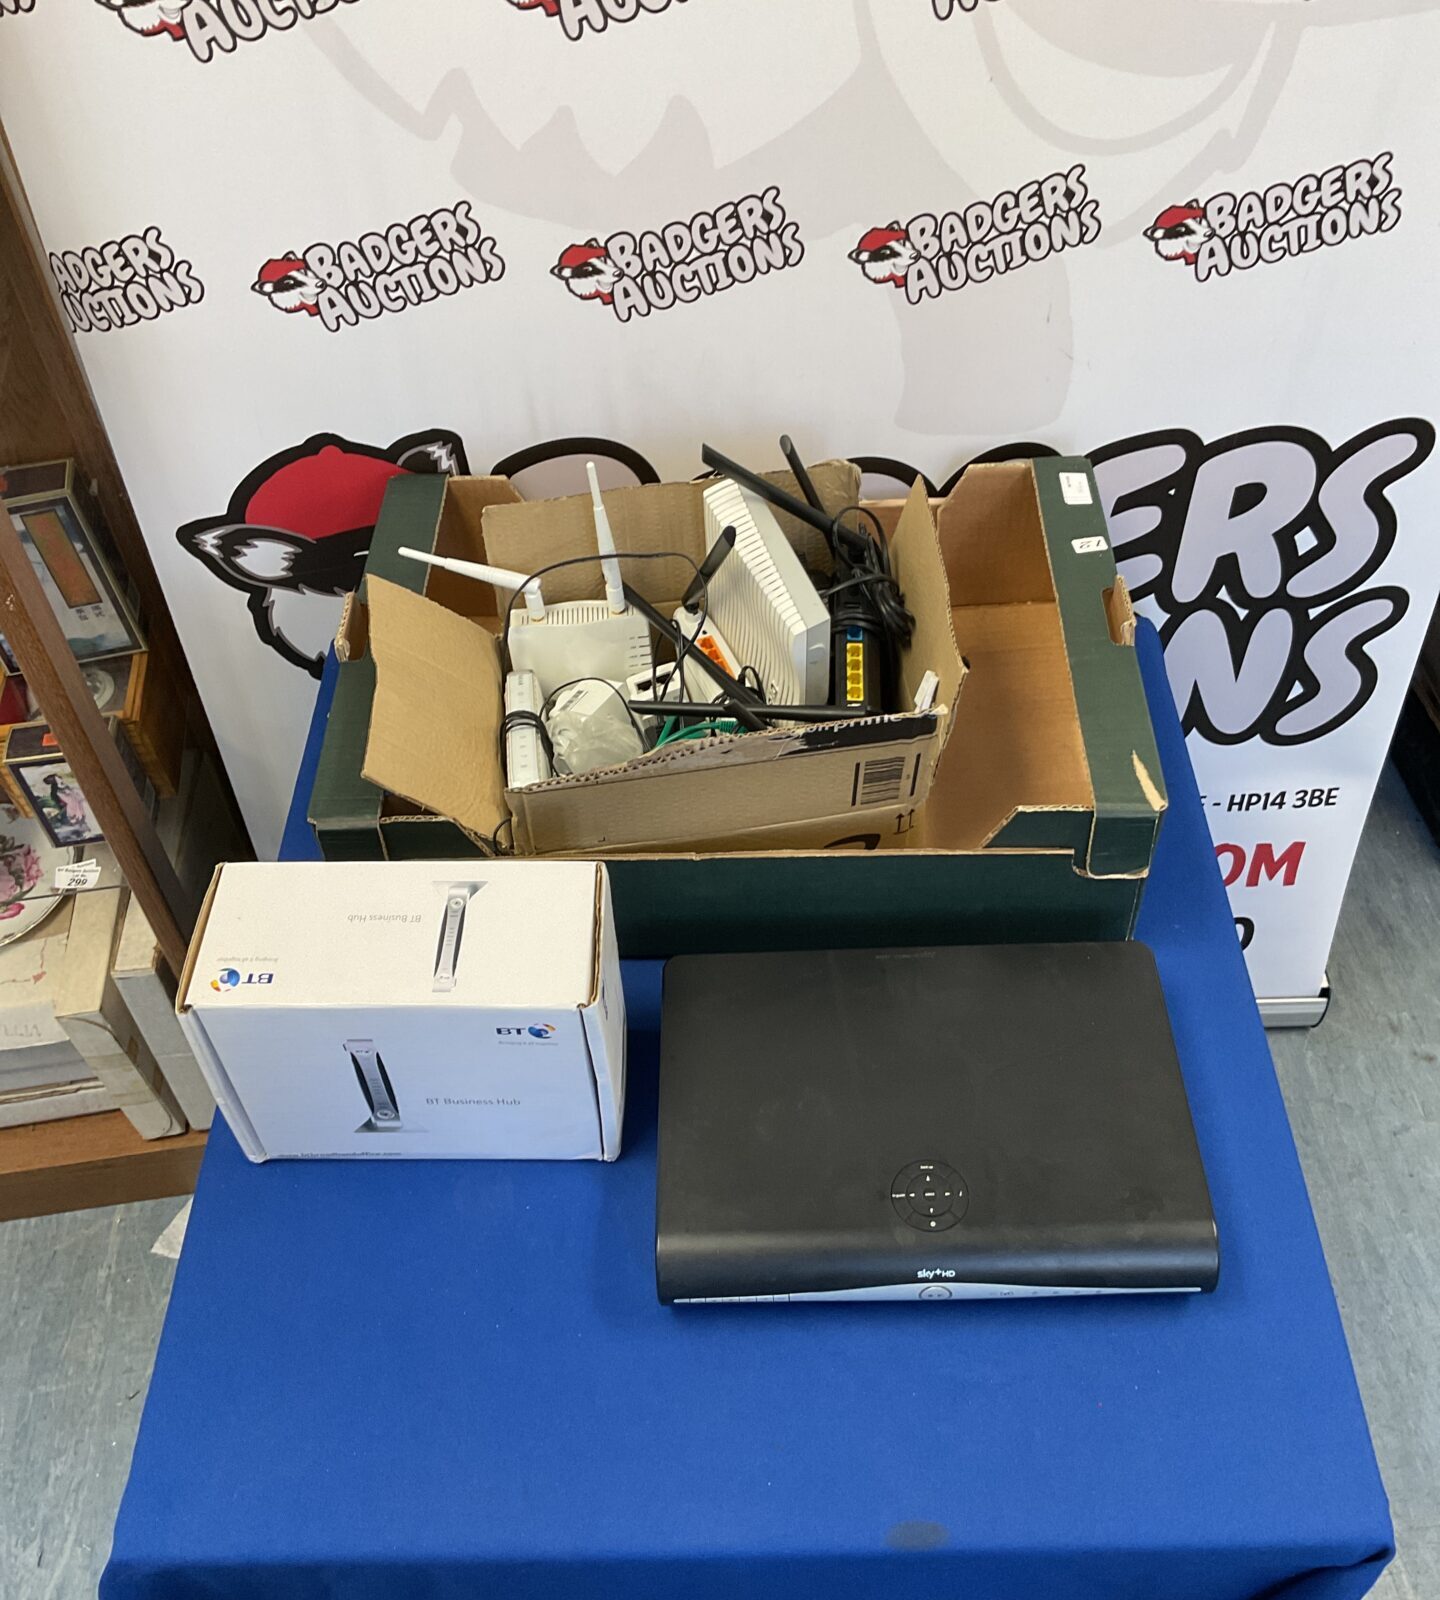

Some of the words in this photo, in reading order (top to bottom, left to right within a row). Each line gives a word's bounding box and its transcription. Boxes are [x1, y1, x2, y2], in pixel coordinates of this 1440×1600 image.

[905, 163, 1089, 261] BADGERS
[1203, 151, 1394, 239] BADGERS
[48, 225, 175, 294] ADGERS
[302, 200, 482, 290] BADGERS
[603, 185, 787, 279] BADGERS
[904, 199, 1102, 305] AUCTIONS
[1195, 187, 1403, 283] AUCTIONS
[60, 259, 205, 333] UCTIONS
[317, 236, 506, 333] AUCTIONS
[612, 221, 806, 323] AUCTIONS
[1226, 790, 1288, 812] HP14
[1291, 787, 1340, 809] 3BE
[67, 878, 88, 886] 299
[347, 914, 367, 923] Hub
[369, 914, 408, 923] Business
[409, 914, 422, 923] BT
[241, 972, 275, 984] BT
[495, 1027, 526, 1036] BT
[425, 1097, 440, 1105] BT
[444, 1097, 494, 1106] Business
[496, 1098, 521, 1106] Hub
